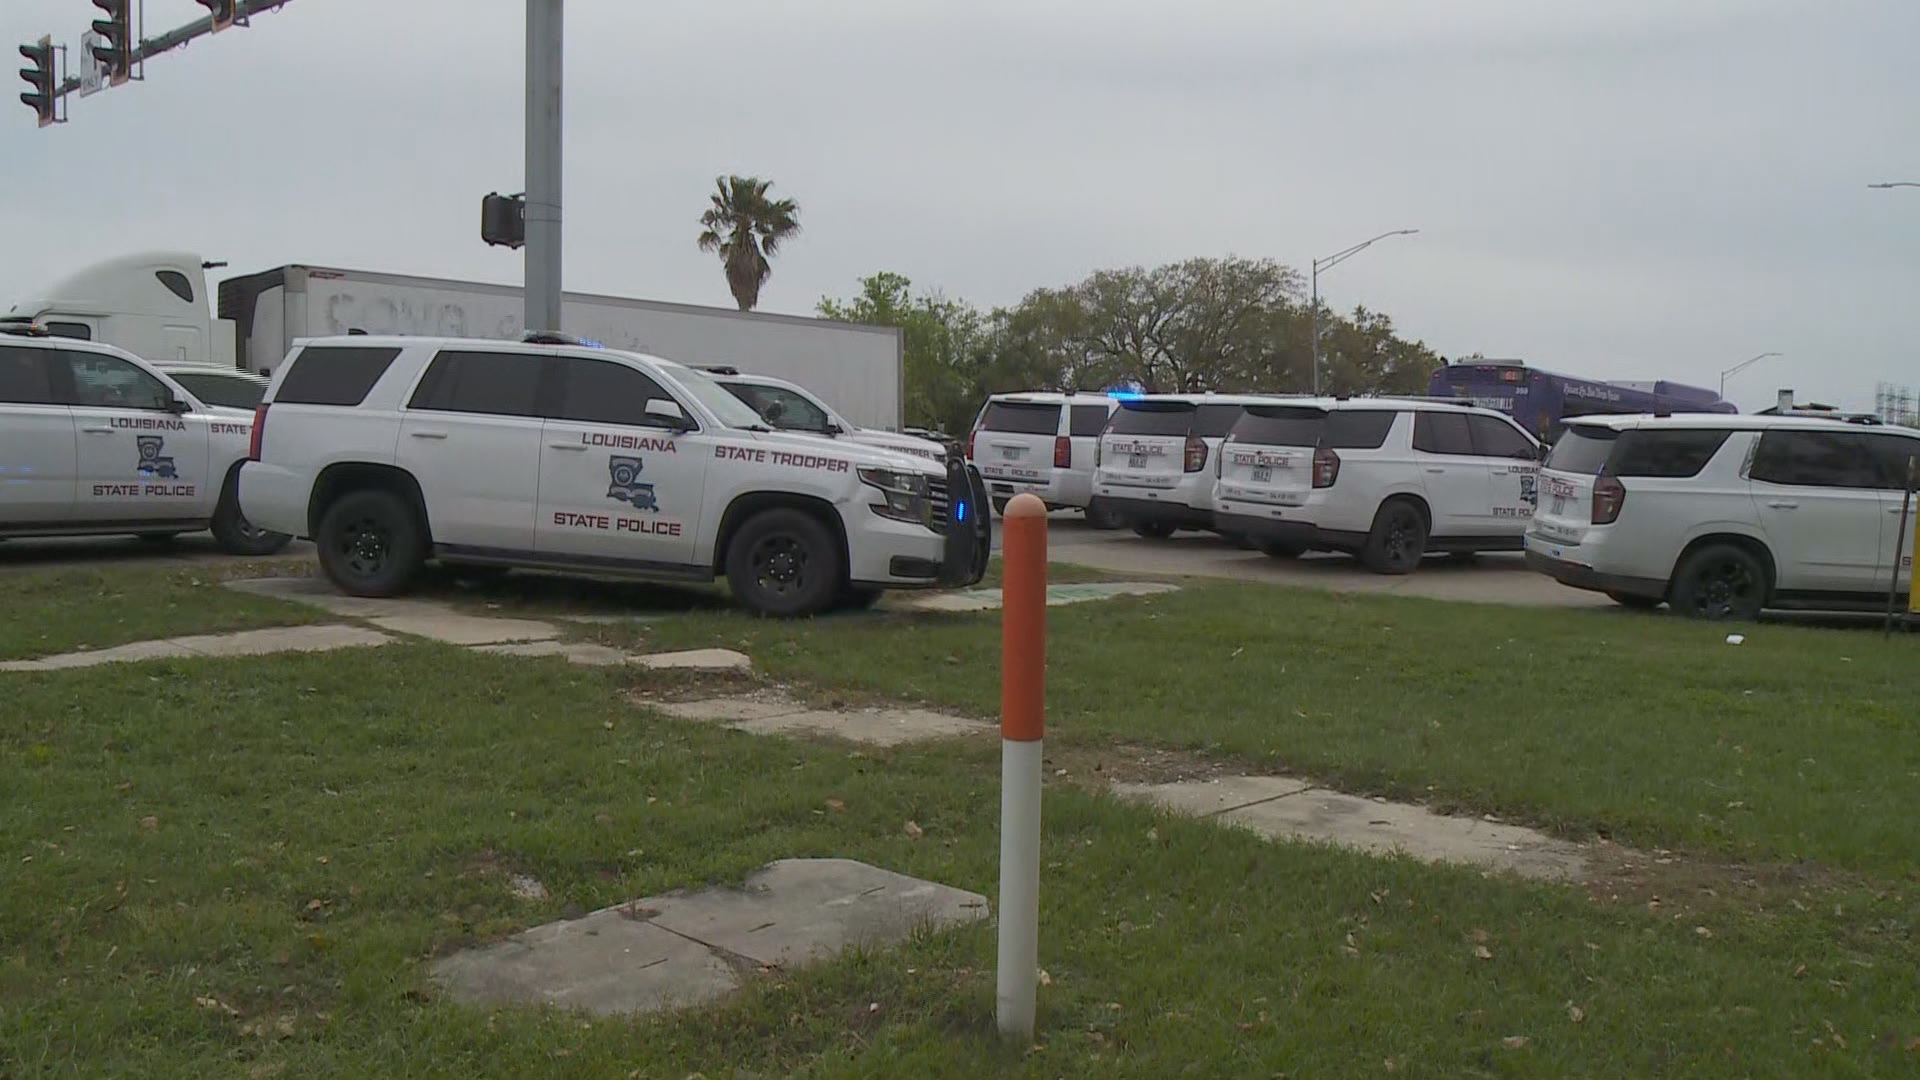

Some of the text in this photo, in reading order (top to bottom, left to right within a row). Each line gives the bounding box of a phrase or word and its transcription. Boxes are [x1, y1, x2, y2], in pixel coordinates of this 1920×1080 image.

[110, 417, 186, 431] LOUISIANA
[211, 423, 247, 435] STATE
[582, 432, 677, 453] LOUISIANA
[1113, 444, 1164, 455] STATE POLICE
[715, 445, 849, 473] STATE TROOPER
[1234, 454, 1289, 466] STATE POLICE
[984, 466, 1039, 477] STATE POLICE
[93, 485, 196, 497] STATE POLICE
[1552, 483, 1575, 496] POLICE
[1492, 507, 1534, 517] STATE POL
[554, 512, 682, 536] STATE POLICE
